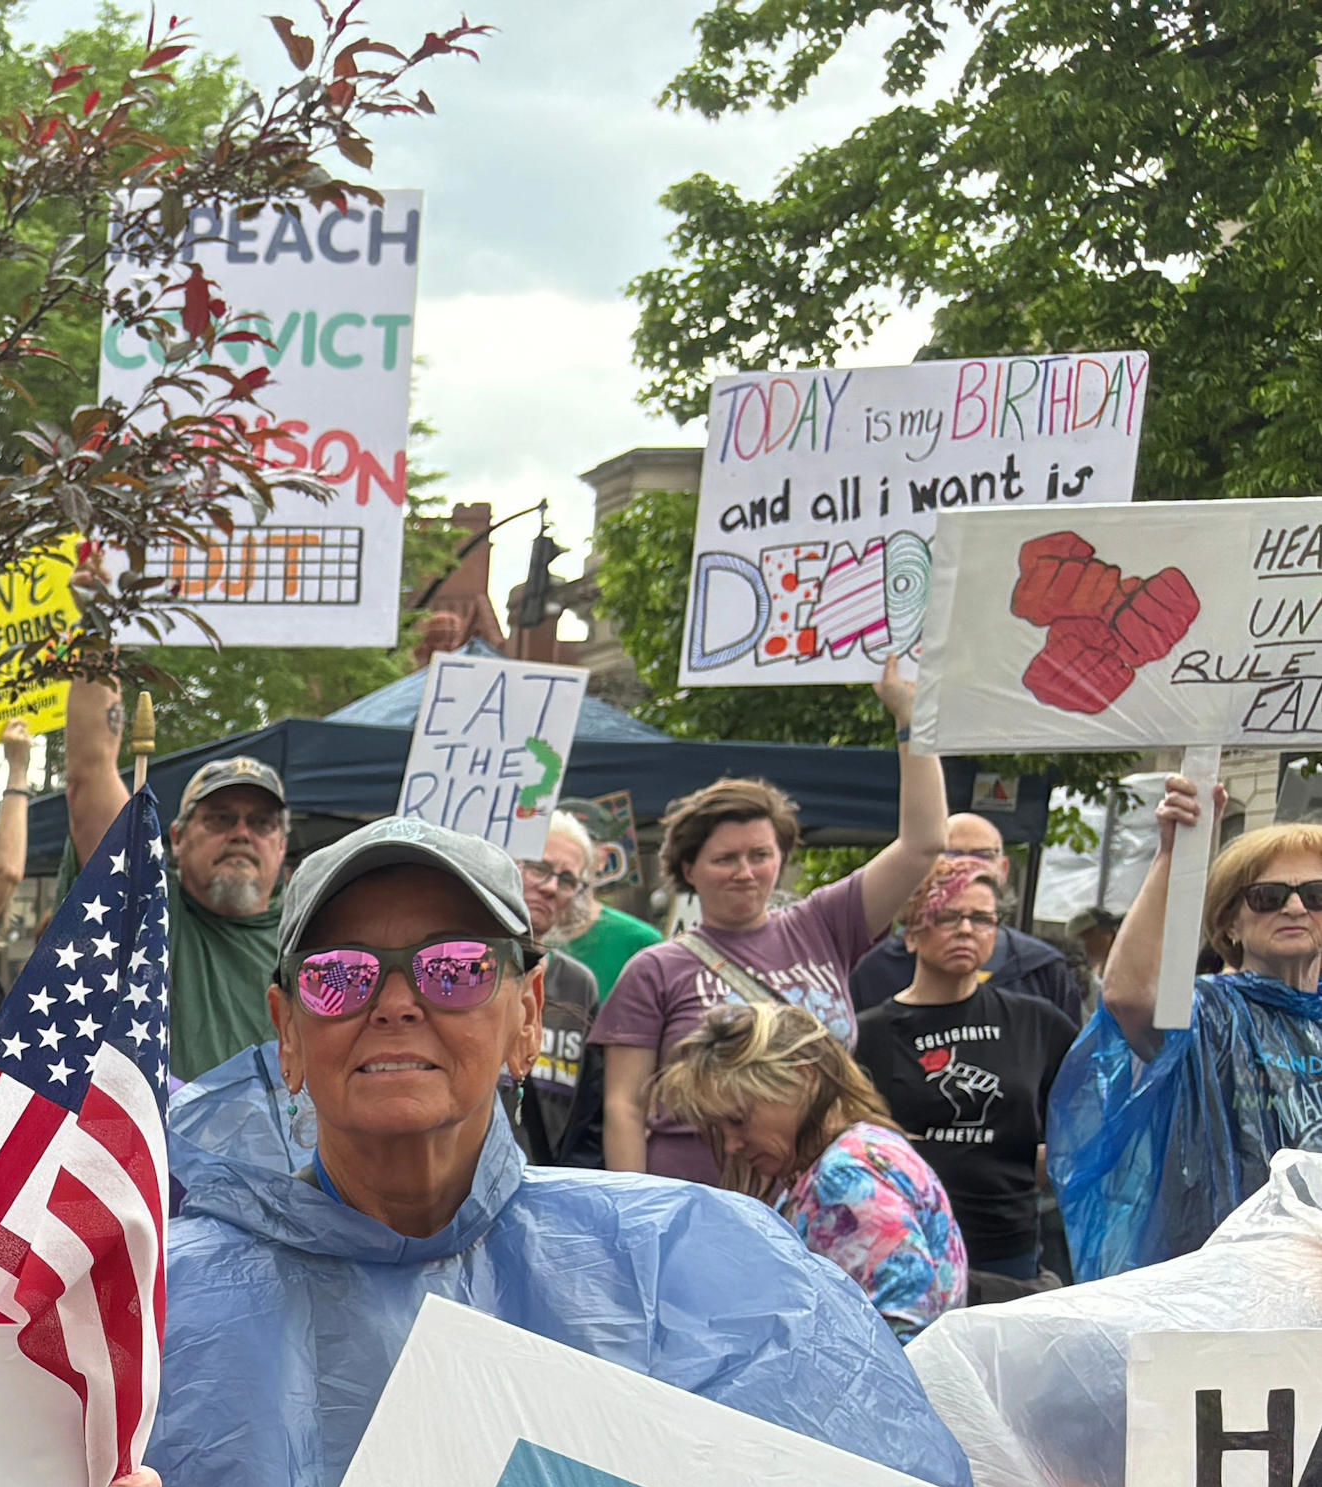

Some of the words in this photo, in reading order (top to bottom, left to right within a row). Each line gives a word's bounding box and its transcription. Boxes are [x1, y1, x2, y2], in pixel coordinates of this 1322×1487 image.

[718, 371, 853, 463] TODAY
[864, 407, 892, 443] is
[899, 405, 944, 462] my
[951, 355, 1148, 442] BIRTHDAY
[719, 477, 791, 533] and
[810, 474, 861, 524] all
[908, 453, 1025, 514] want
[1046, 463, 1094, 501] is
[688, 529, 933, 673] DEMO
[424, 662, 579, 742] EAT
[434, 742, 527, 778] THE
[914, 1025, 1001, 1051] SOLIDARITY
[924, 1127, 995, 1144] FOREVER
